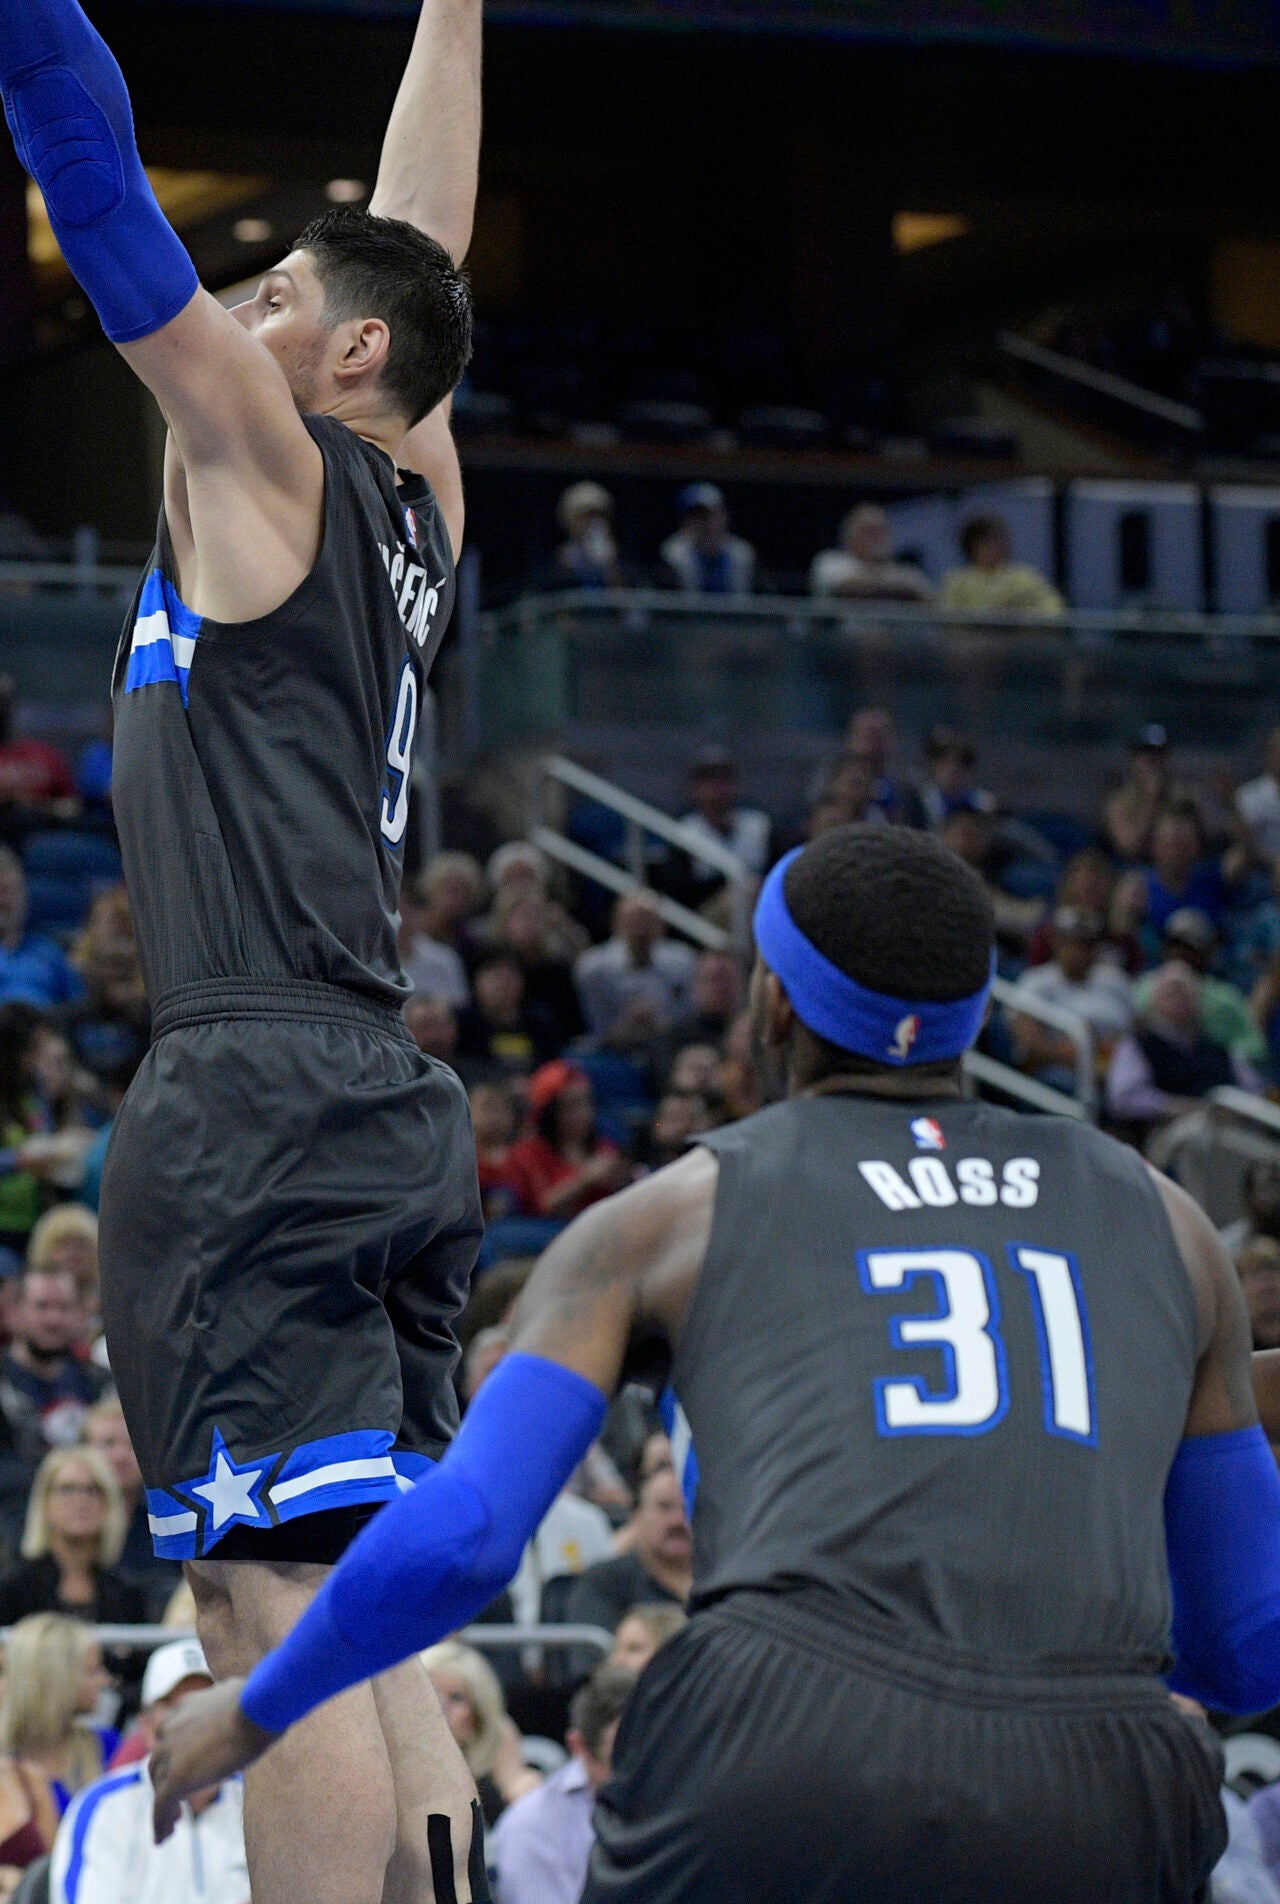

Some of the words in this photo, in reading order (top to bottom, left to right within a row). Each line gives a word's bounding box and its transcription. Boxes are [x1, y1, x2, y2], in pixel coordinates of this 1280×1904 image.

[380, 653, 418, 850] 9
[857, 1156, 1041, 1211] ROSS
[853, 1241, 1099, 1449] 31
